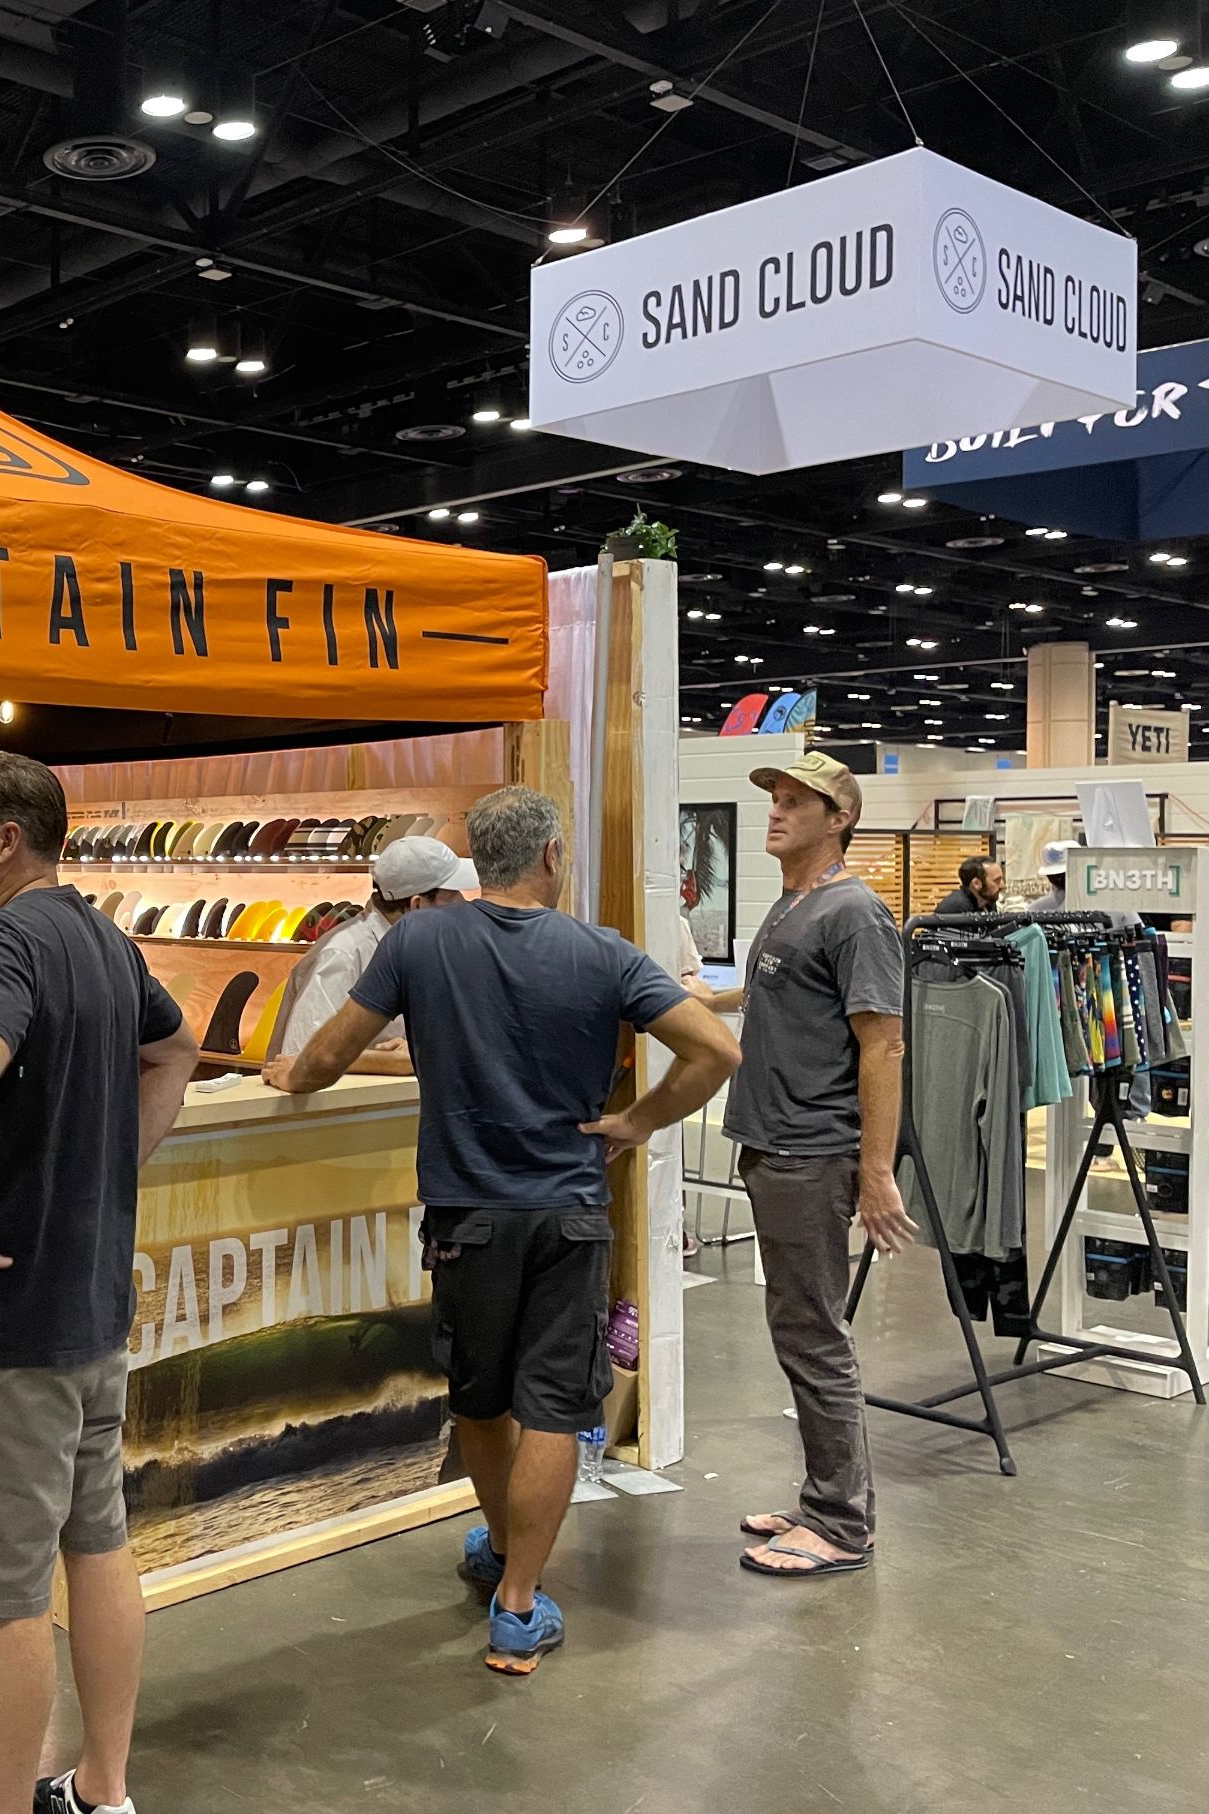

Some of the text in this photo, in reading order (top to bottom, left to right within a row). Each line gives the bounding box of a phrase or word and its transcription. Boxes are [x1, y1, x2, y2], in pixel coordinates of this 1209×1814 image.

[642, 222, 894, 350] SAND CLOUD
[997, 248, 1127, 352] SAND CLOUD
[266, 577, 400, 669] FIN
[1128, 724, 1170, 754] YETI
[128, 1211, 388, 1369] CAPTAIN
